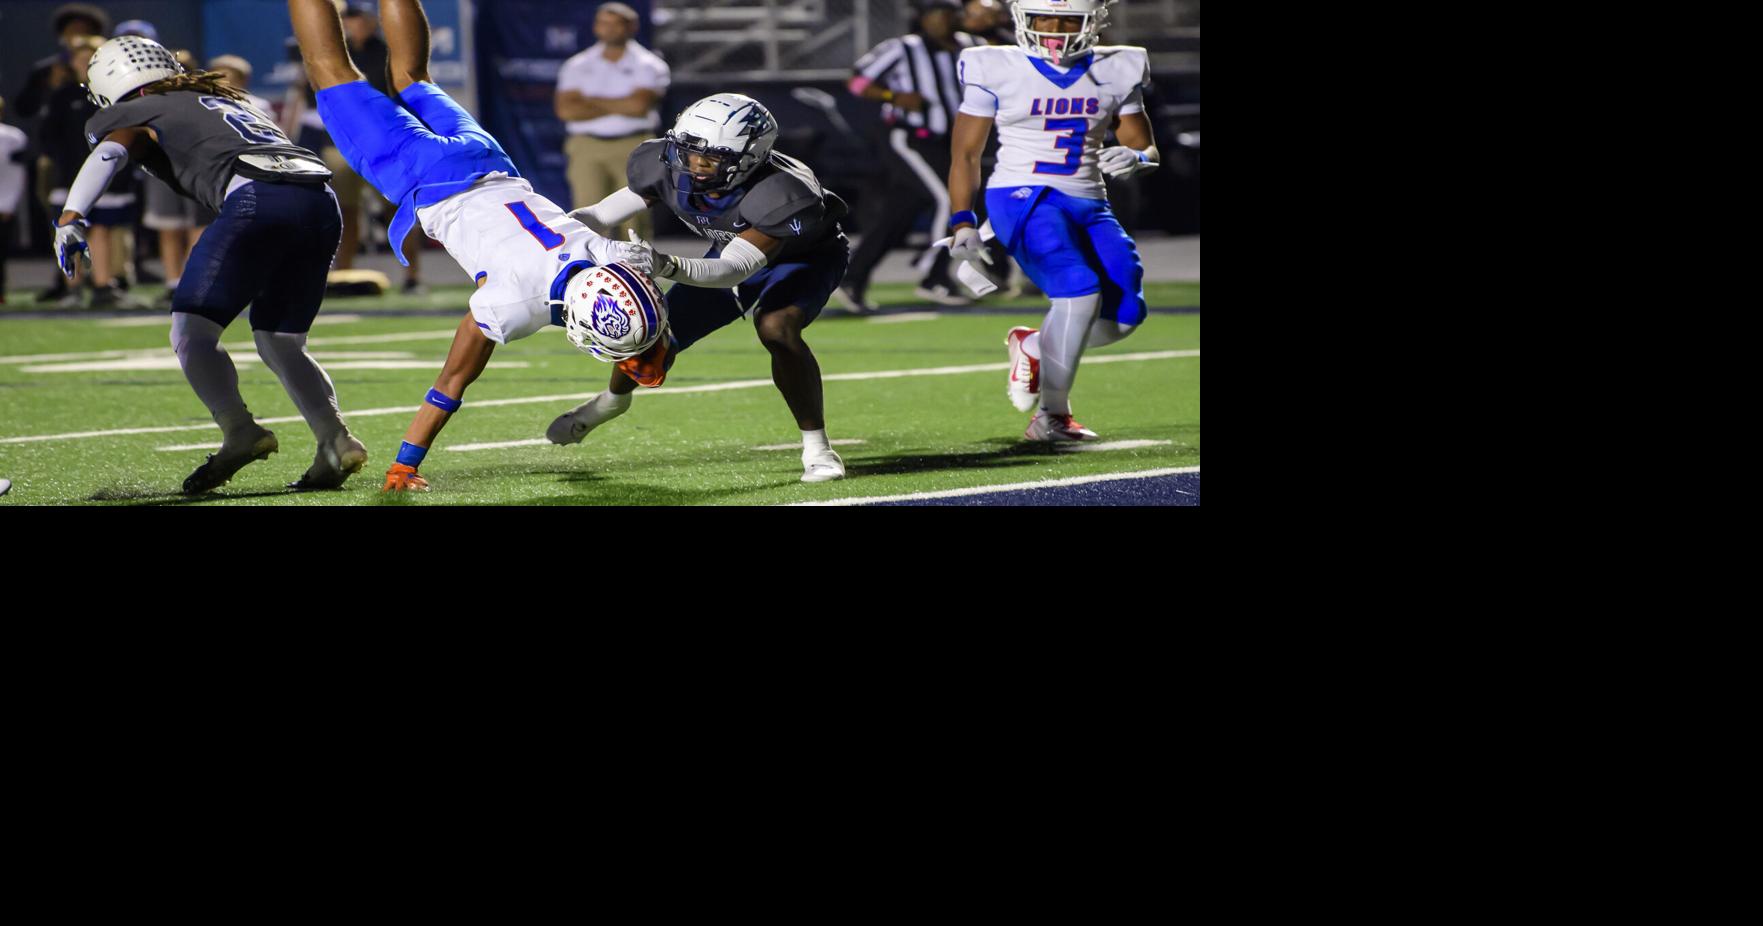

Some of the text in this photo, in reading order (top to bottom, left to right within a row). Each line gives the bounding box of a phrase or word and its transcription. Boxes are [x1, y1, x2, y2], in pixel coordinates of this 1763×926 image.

[1030, 97, 1099, 116] LIONS
[1033, 118, 1088, 175] 3
[504, 201, 565, 251] 1
